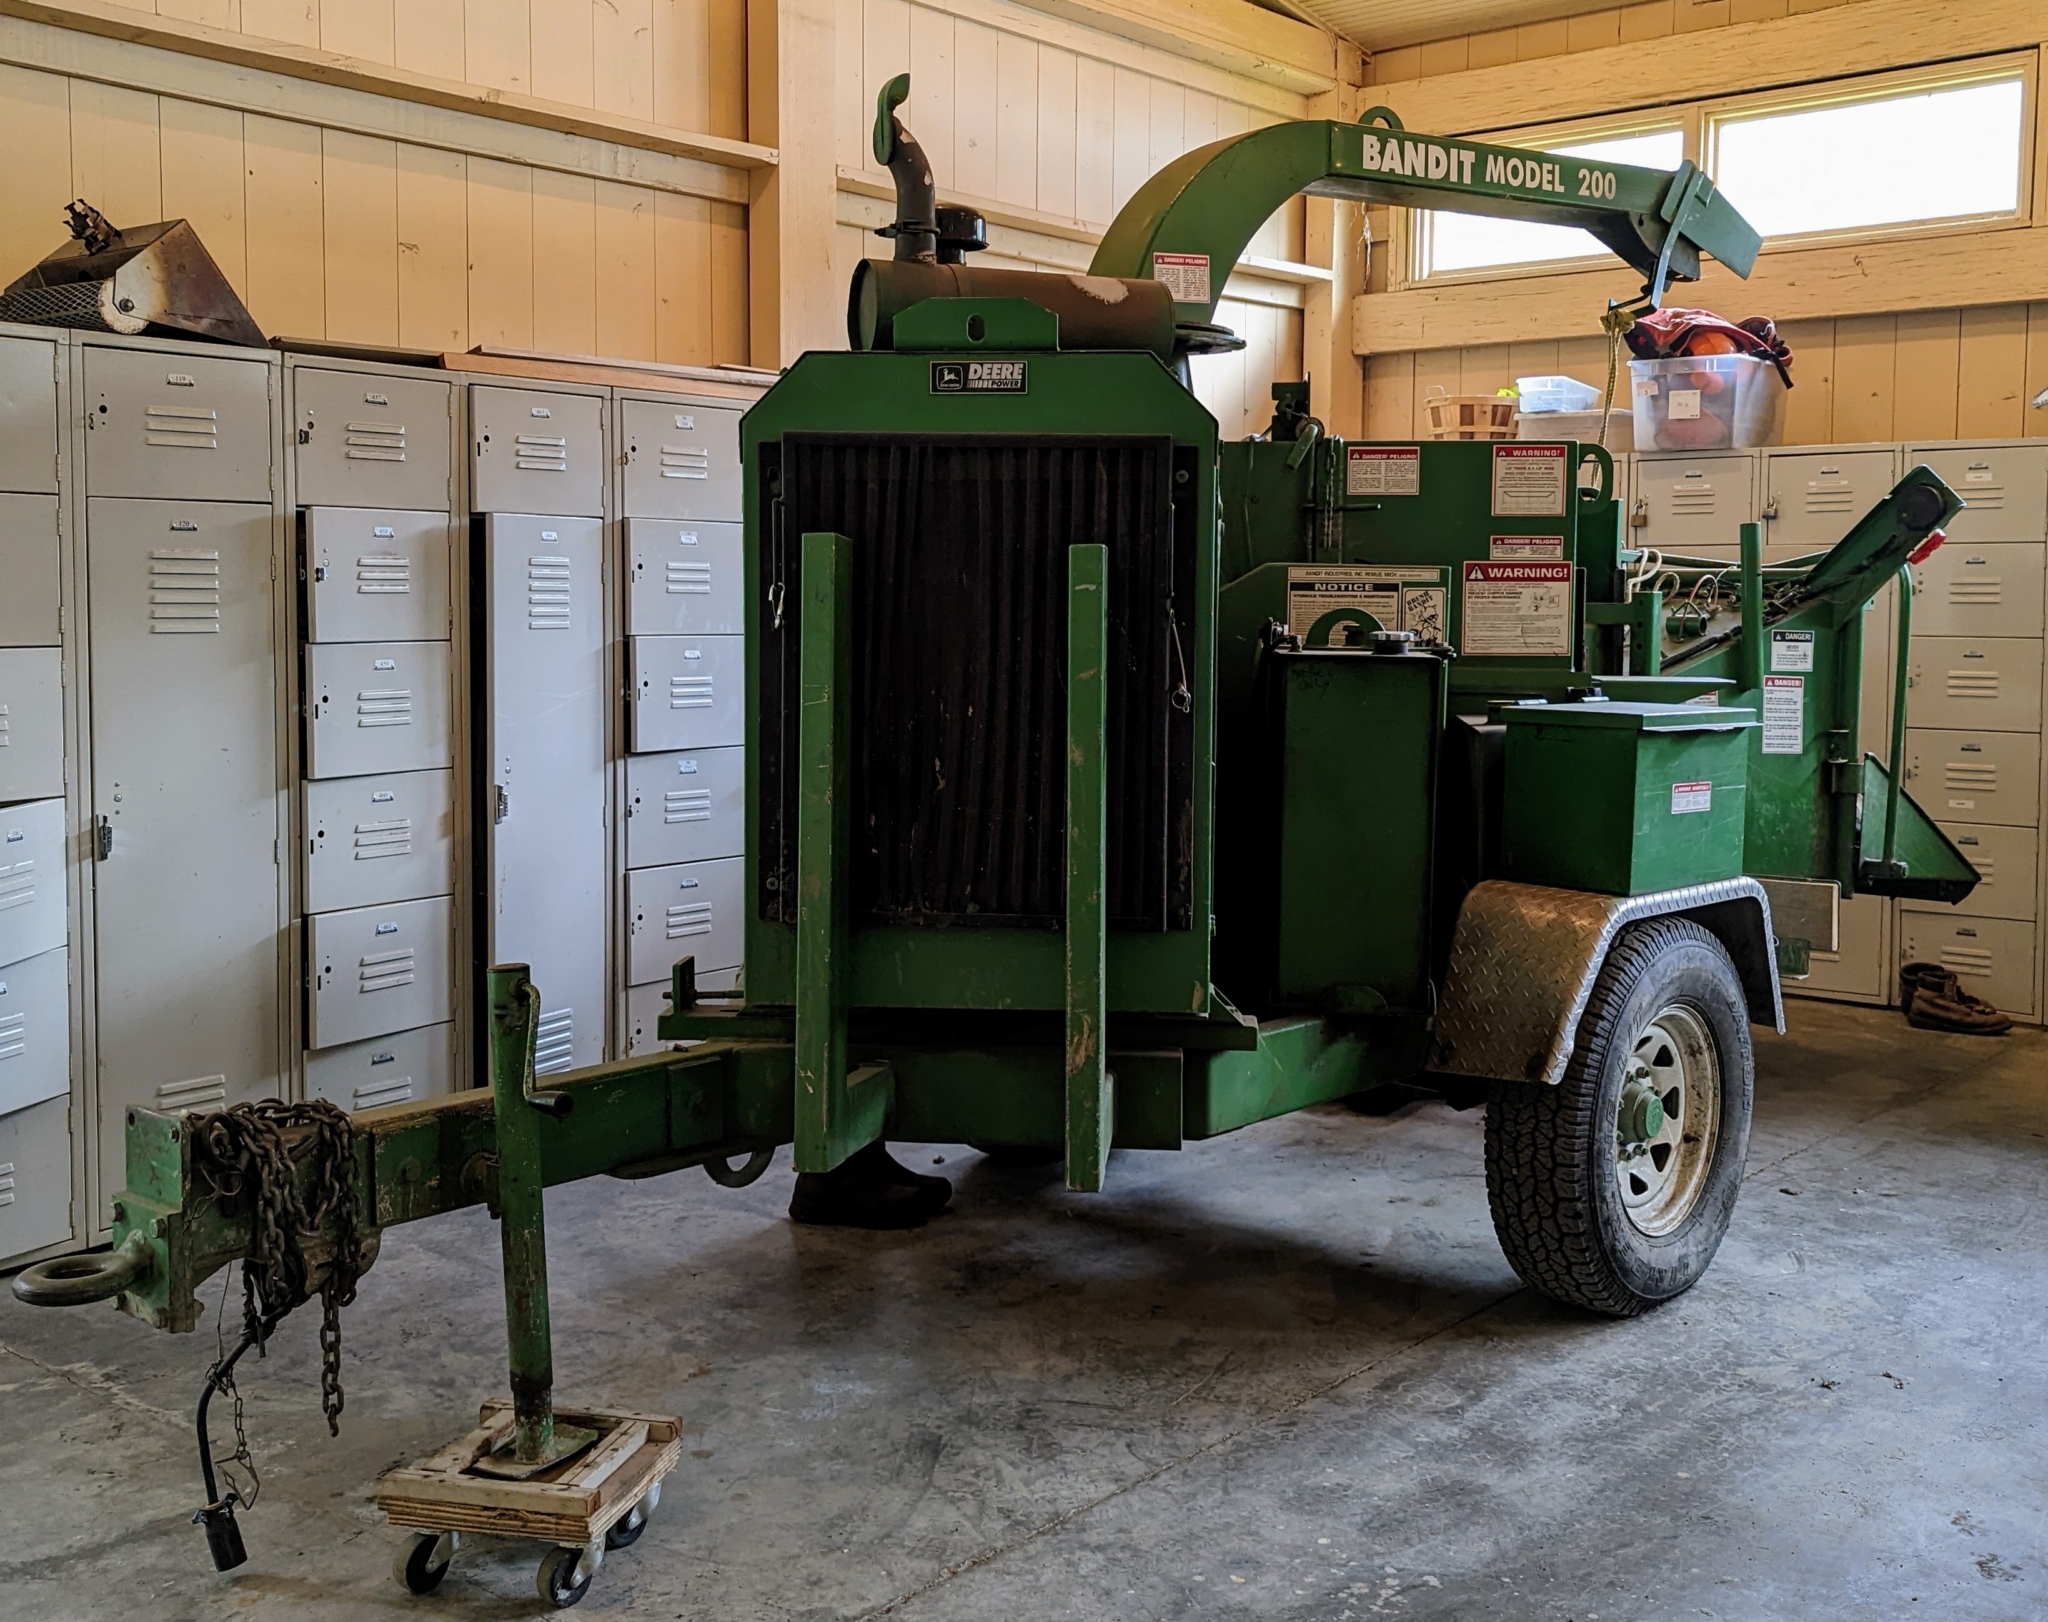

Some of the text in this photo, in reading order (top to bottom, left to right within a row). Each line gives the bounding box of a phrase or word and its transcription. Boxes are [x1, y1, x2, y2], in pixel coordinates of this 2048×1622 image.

[1362, 133, 1617, 200] BANDIT MODEL 200
[968, 363, 1024, 379] DEERE
[990, 380, 1020, 388] POWER
[1512, 449, 1560, 457] WARNING!
[1487, 567, 1568, 578] WARNING!
[1314, 583, 1374, 591] NOTICE
[1406, 590, 1430, 607] BRUSH
[1408, 595, 1433, 612] BANDIT
[1784, 632, 1812, 641] DANGER!
[1774, 679, 1802, 687] DANGER!
[1729, 998, 1752, 1113] DAYTON
